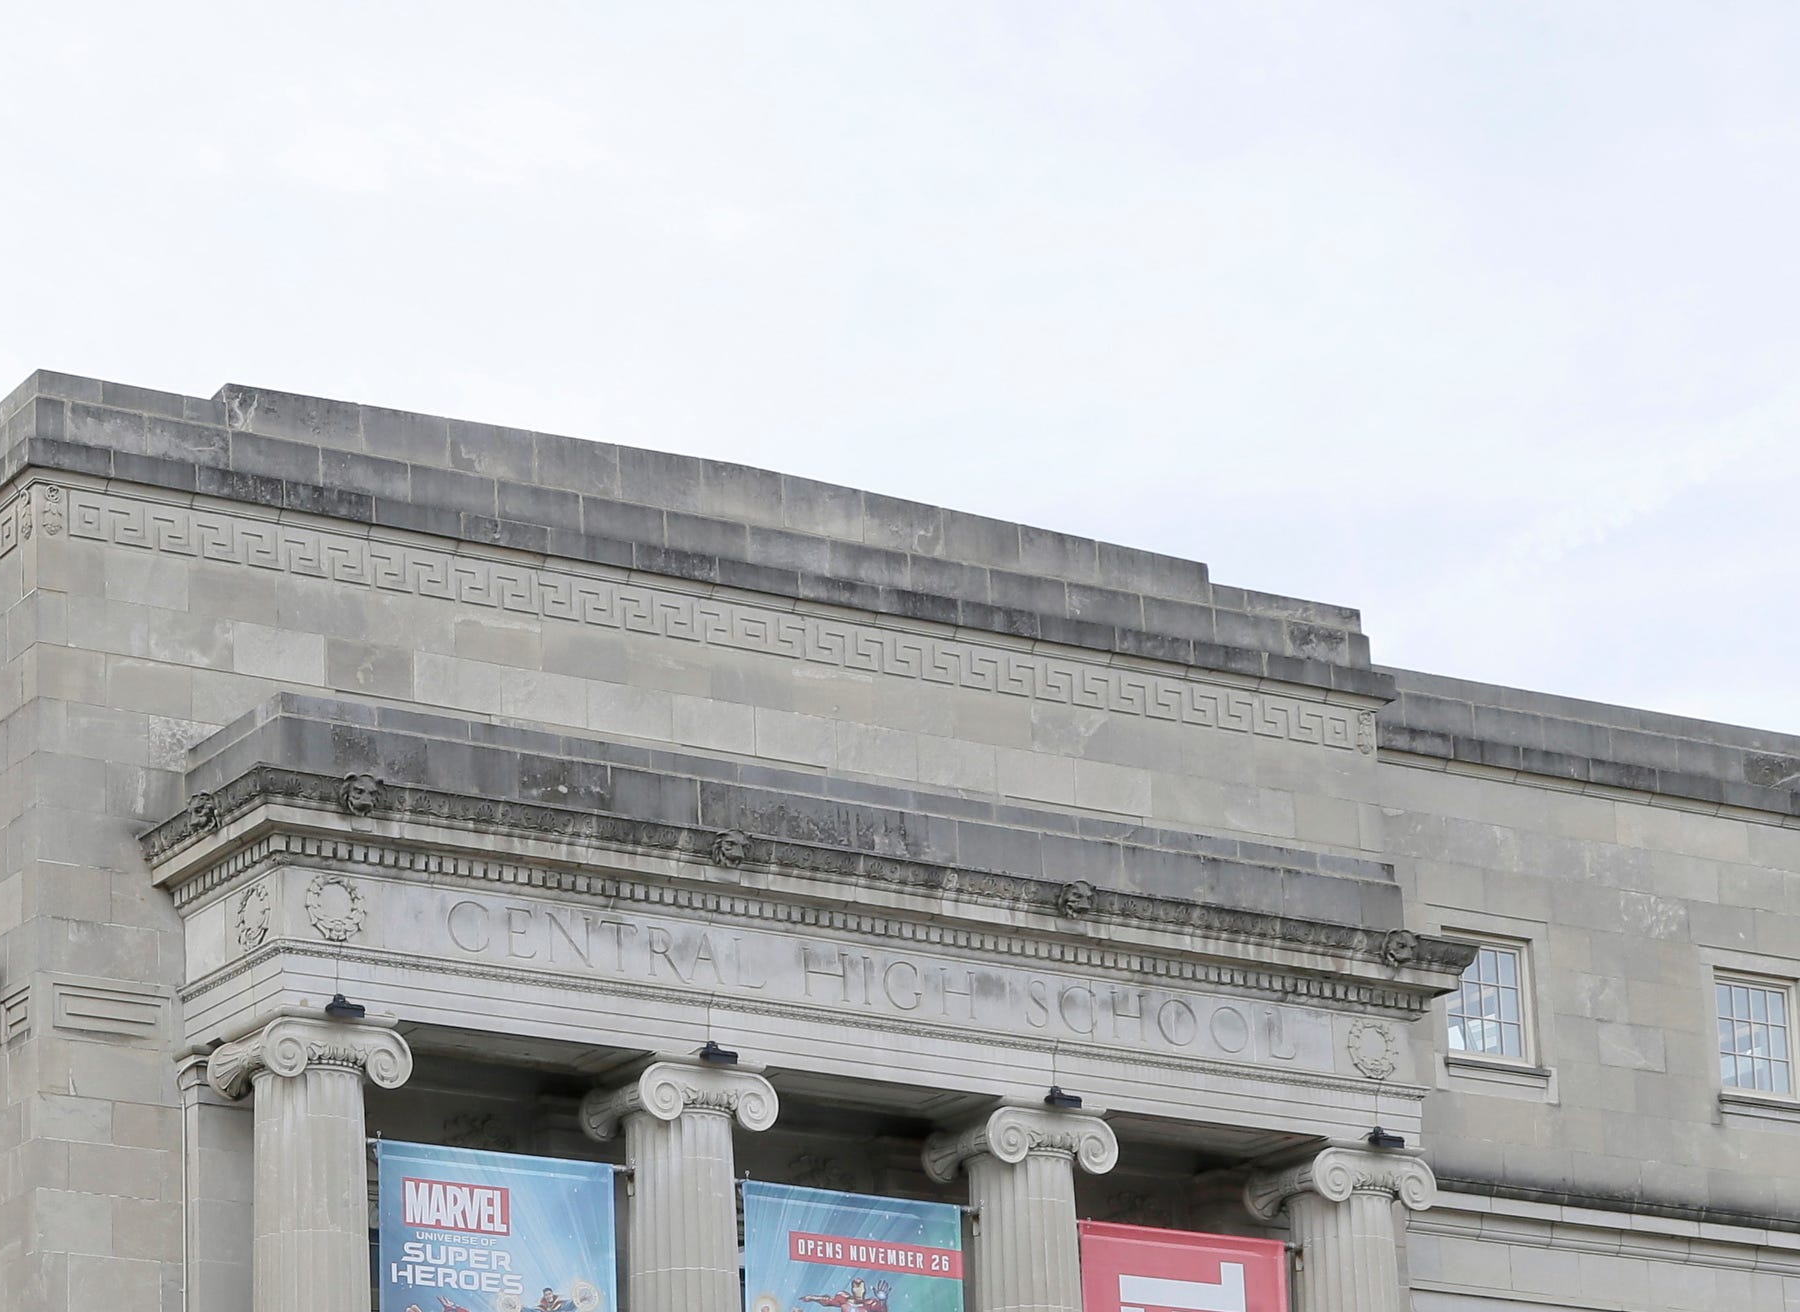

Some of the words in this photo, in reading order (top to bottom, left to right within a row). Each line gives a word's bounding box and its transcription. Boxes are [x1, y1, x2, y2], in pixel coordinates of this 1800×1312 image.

[447, 900, 767, 989] CENTRAL
[802, 947, 977, 1019] HIGH
[1026, 979, 1296, 1061] SCHOOL
[404, 1180, 508, 1233] MARVEL
[416, 1231, 479, 1246] UNIVERSE
[479, 1236, 497, 1247] OF
[798, 1238, 843, 1260] OPENS
[850, 1244, 924, 1270] NOVEMBER
[931, 1254, 950, 1272] 26
[401, 1241, 513, 1272] SUPER
[391, 1263, 524, 1295] HEROES
